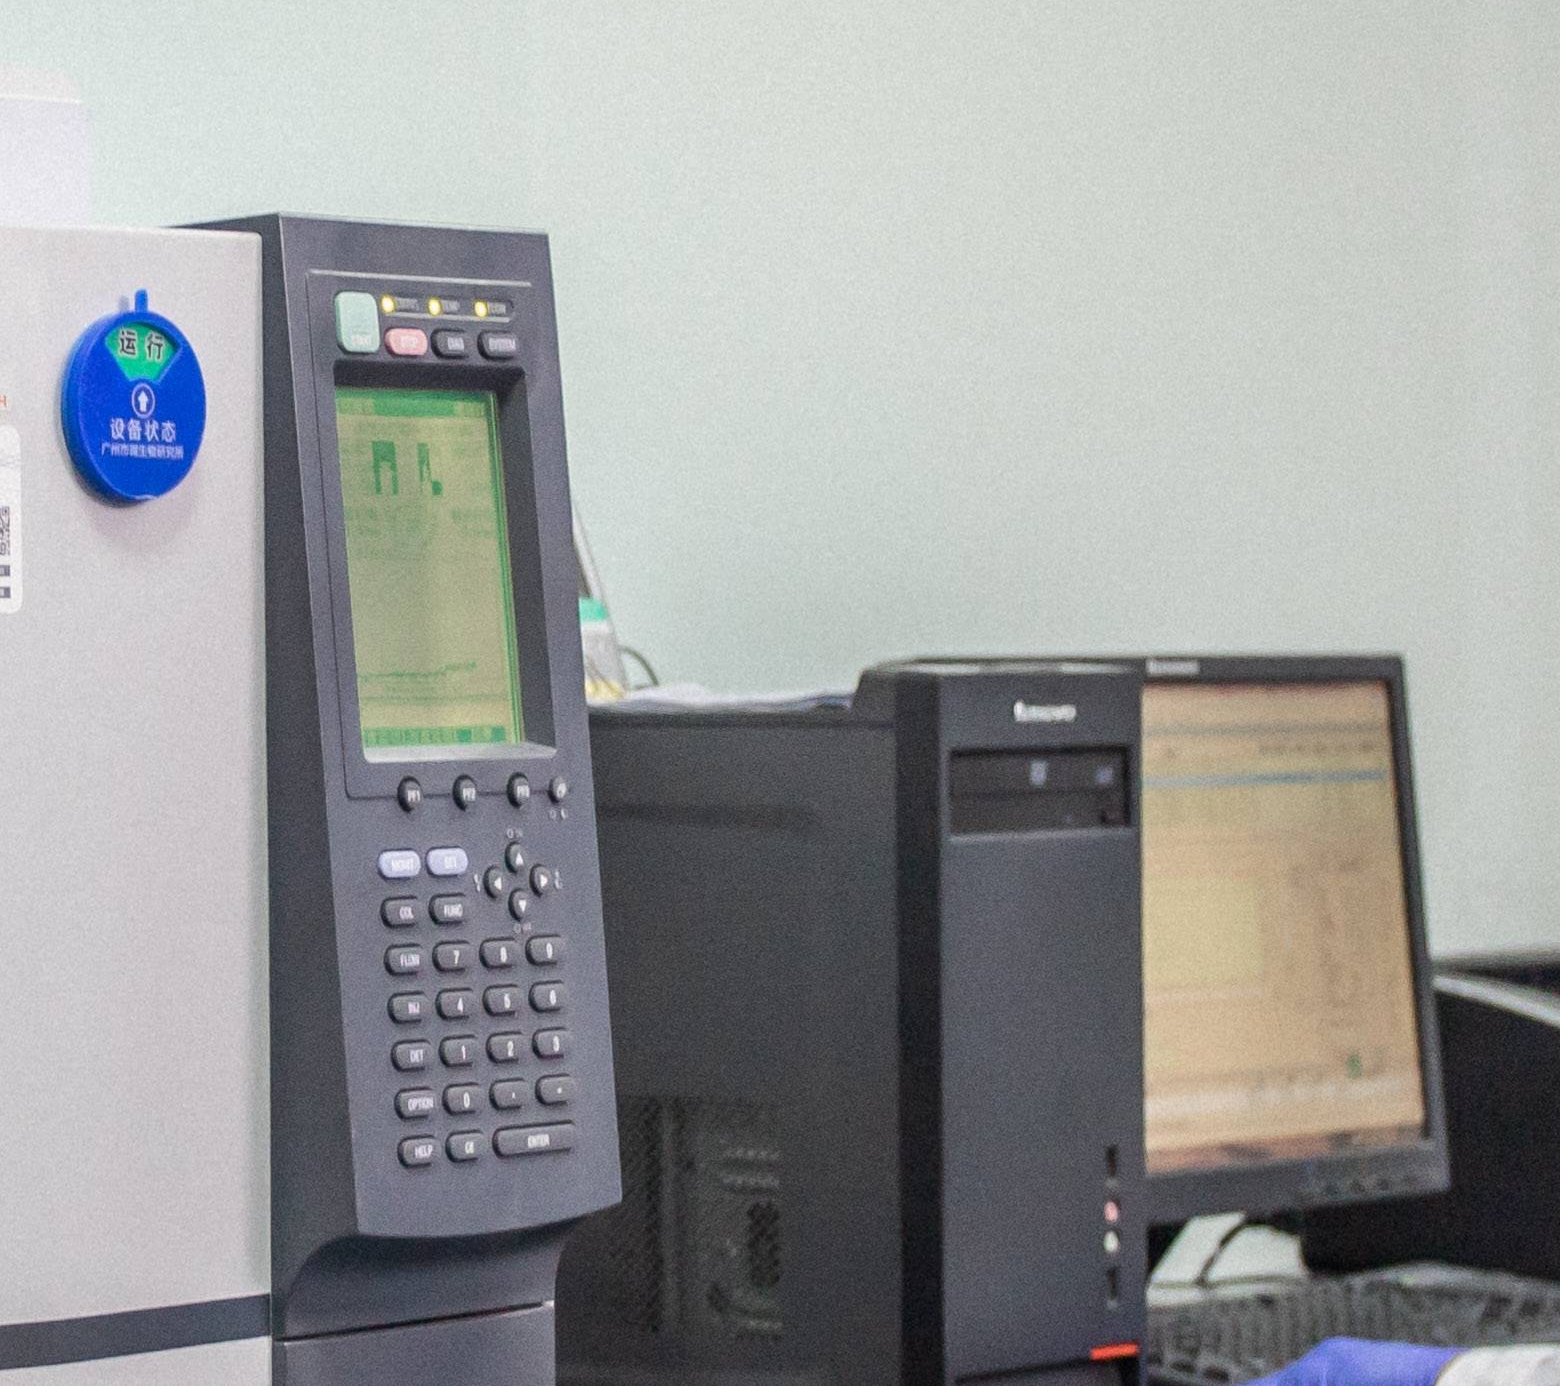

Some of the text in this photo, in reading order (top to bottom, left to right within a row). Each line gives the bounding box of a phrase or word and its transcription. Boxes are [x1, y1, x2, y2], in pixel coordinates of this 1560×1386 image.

[120, 329, 164, 361] 运行
[110, 418, 177, 443] 设备状态
[452, 949, 460, 966] 7
[457, 996, 464, 1013] 4
[460, 1044, 466, 1061] 1
[507, 1040, 515, 1057] 2
[463, 1092, 470, 1109] 0
[414, 1144, 433, 1159] HELP
